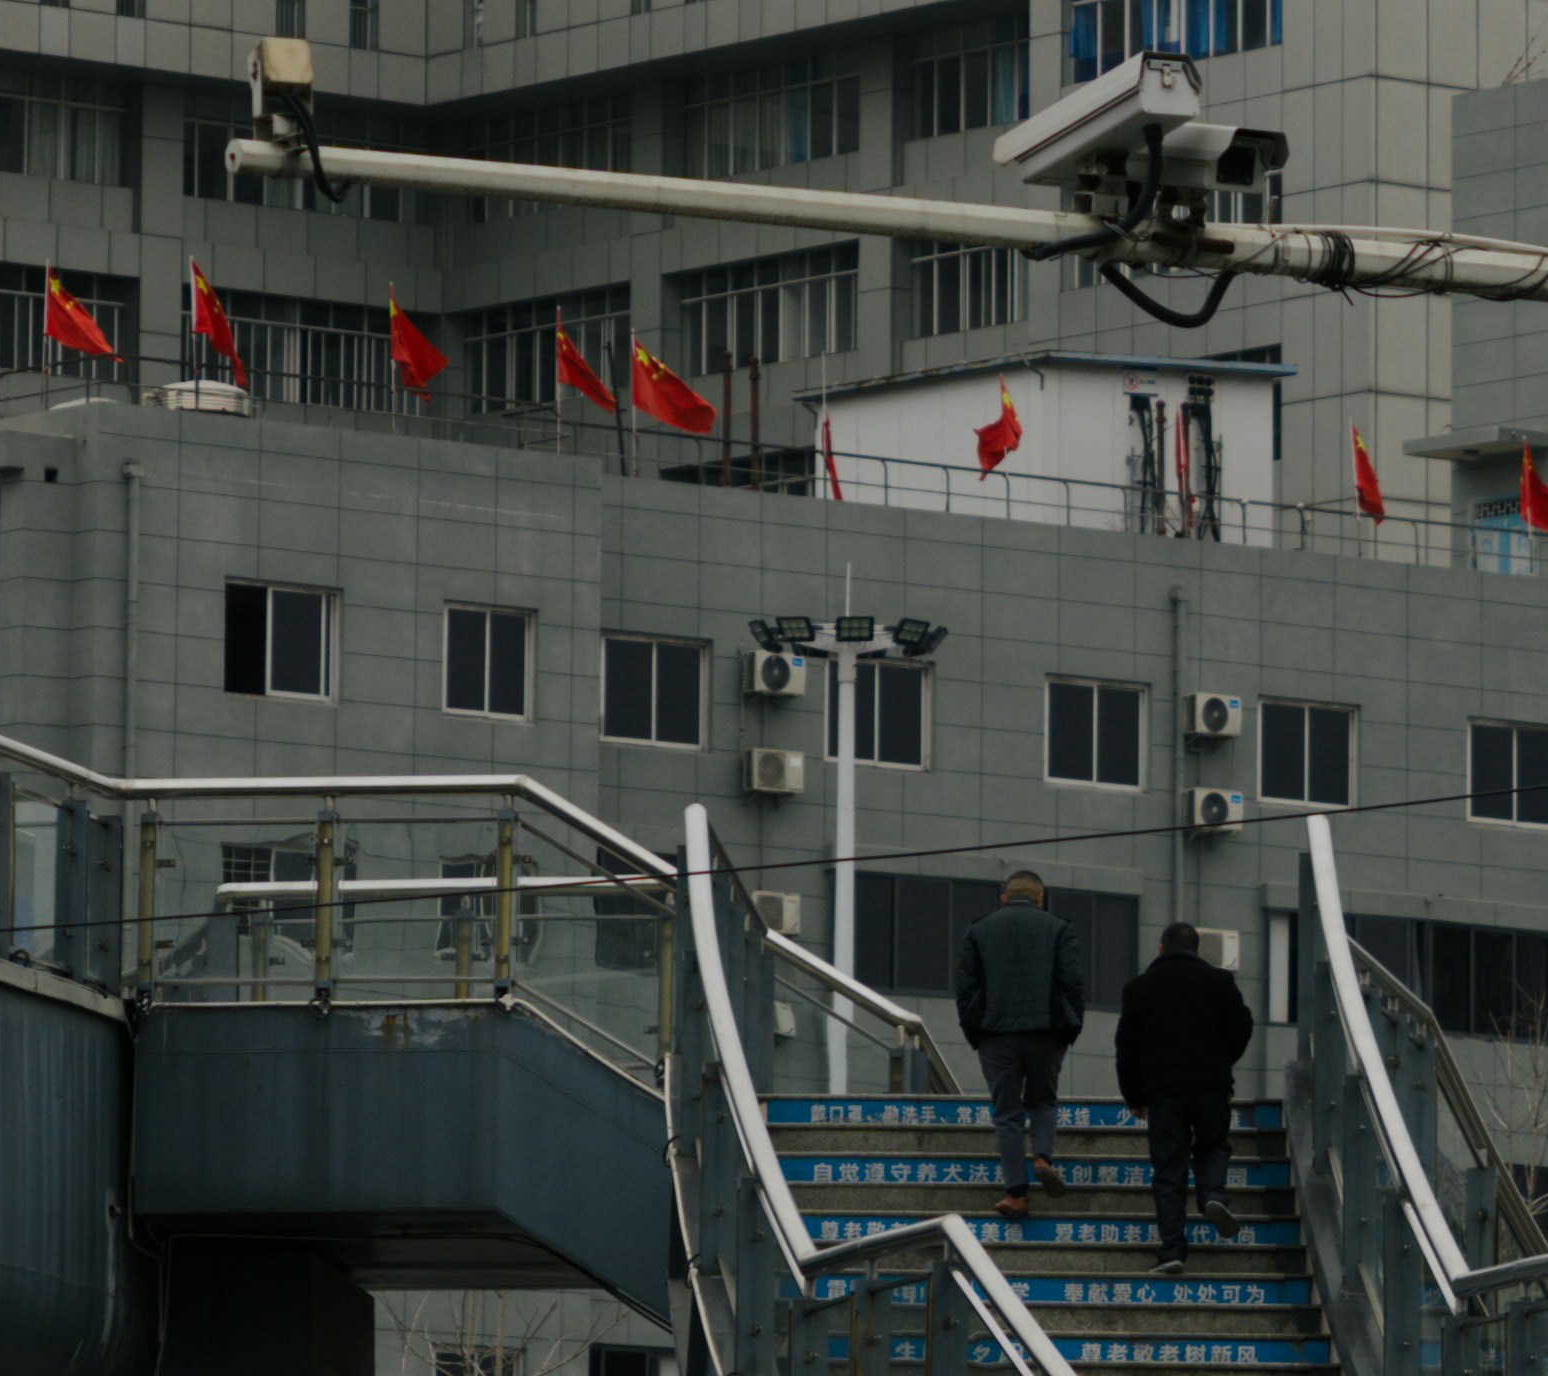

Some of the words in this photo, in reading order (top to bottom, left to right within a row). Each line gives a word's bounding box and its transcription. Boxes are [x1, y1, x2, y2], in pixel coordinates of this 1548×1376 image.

[1064, 1282, 1157, 1304] 奉献爱心
[1173, 1282, 1266, 1304] 处处可为
[1082, 1342, 1258, 1364] 尊老敬老树新风
